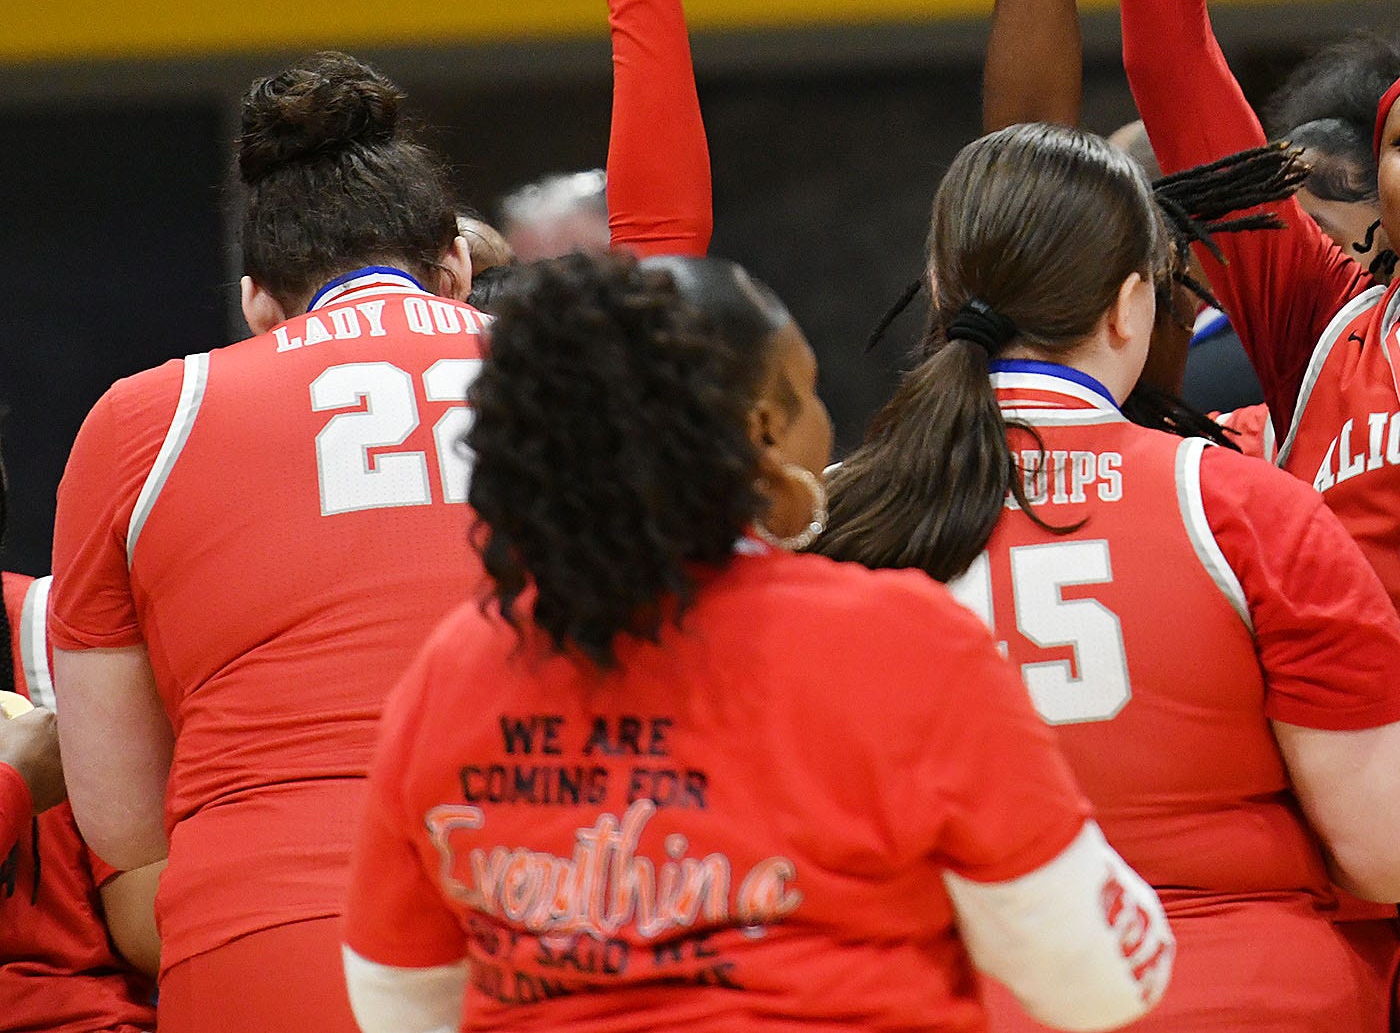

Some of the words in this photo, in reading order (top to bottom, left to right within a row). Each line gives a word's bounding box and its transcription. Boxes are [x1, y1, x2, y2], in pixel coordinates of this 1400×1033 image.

[272, 299, 387, 353] LADY
[499, 714, 564, 754] WE
[582, 715, 674, 756] ARE
[458, 765, 608, 804] COMING
[628, 766, 709, 809] FOR
